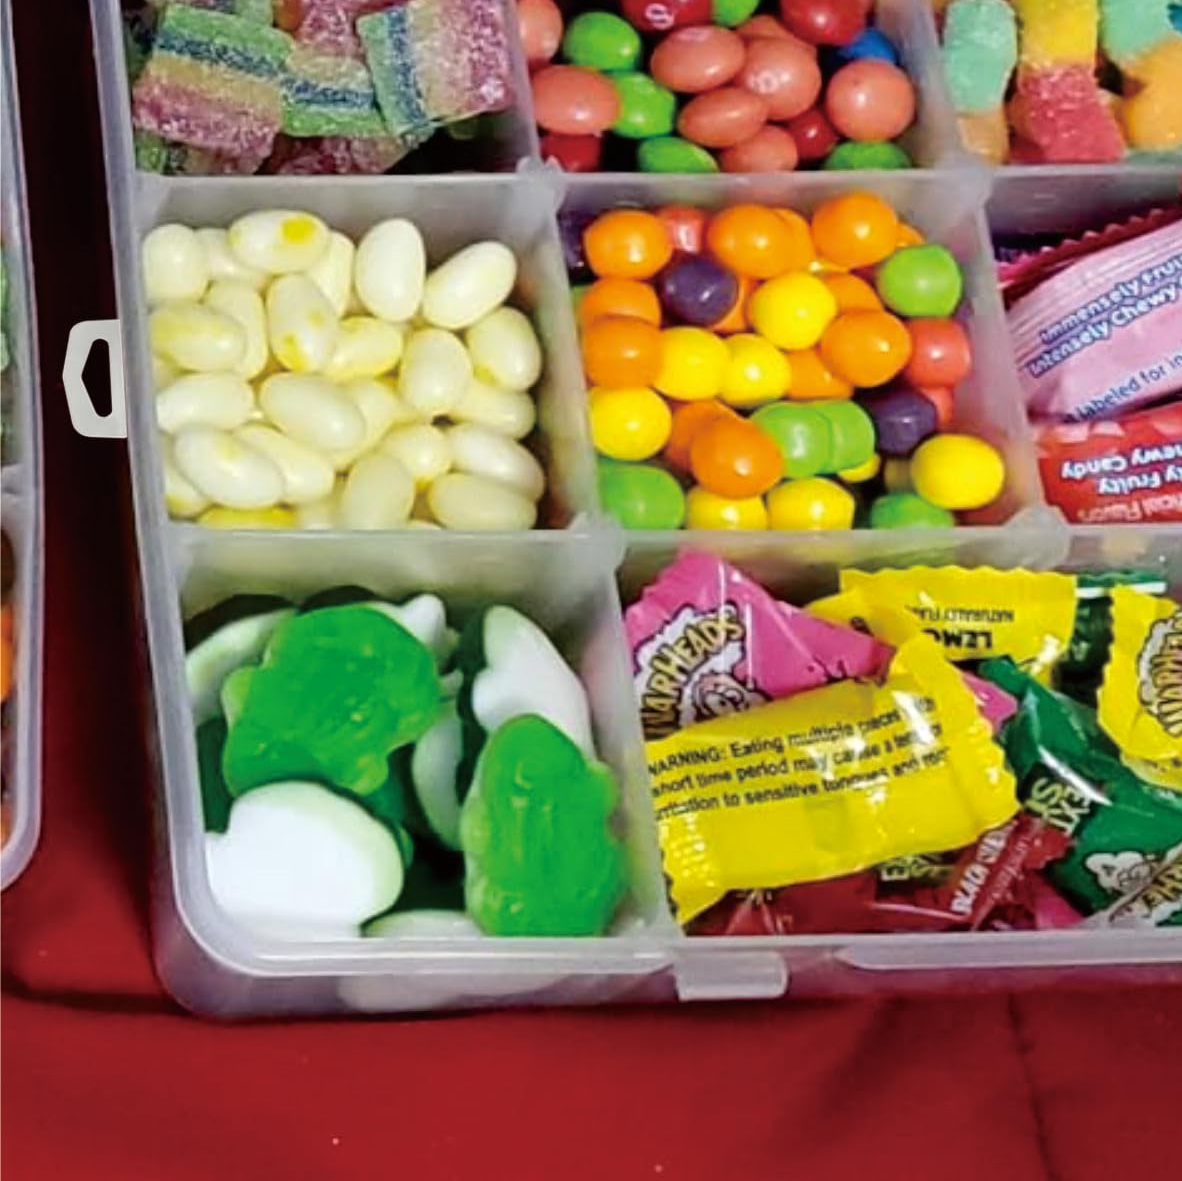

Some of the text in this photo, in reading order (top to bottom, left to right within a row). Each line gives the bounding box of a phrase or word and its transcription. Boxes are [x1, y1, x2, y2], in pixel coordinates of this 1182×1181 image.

[1040, 275, 1144, 344] Immensely
[1029, 316, 1115, 378] Intensely
[1108, 280, 1182, 330] Chewy
[1078, 371, 1142, 422] labeled
[1138, 362, 1168, 388] for
[1060, 450, 1129, 480] Candy
[1096, 465, 1163, 495] Fruity
[729, 734, 786, 760] Eating
[787, 722, 856, 750] multiple
[697, 768, 734, 790] time
[737, 757, 790, 785] period
[723, 791, 741, 809] to
[743, 780, 820, 807] sensitive
